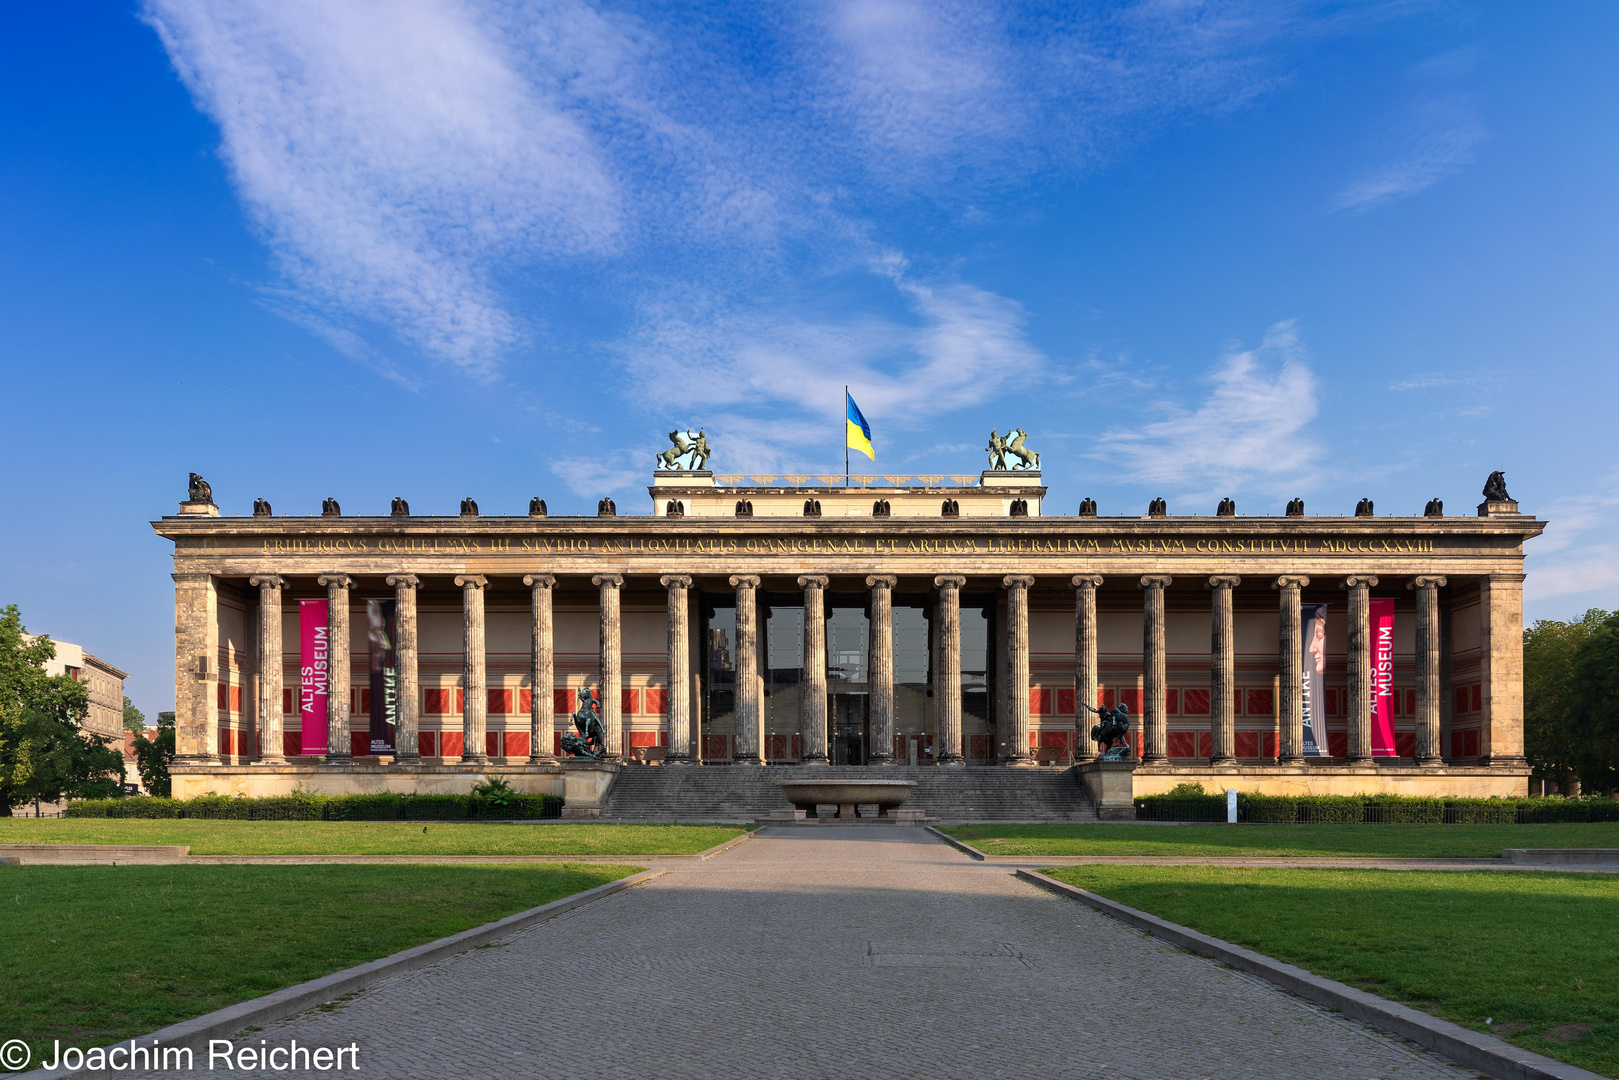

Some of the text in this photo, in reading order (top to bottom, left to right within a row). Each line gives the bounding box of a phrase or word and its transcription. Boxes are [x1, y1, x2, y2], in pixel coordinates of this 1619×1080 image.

[263, 538, 1433, 552] FRIDERICVS GVILELMVS III STVDIO ANTIQVITATIS OMNIGENAE ET ARTIVM LIBERALIVM MVSEVM CONSTITVIT MDCCCXXVIII
[301, 666, 313, 713] ALTES
[314, 626, 328, 695] MUSEUM
[1378, 626, 1392, 696] MUSEUM
